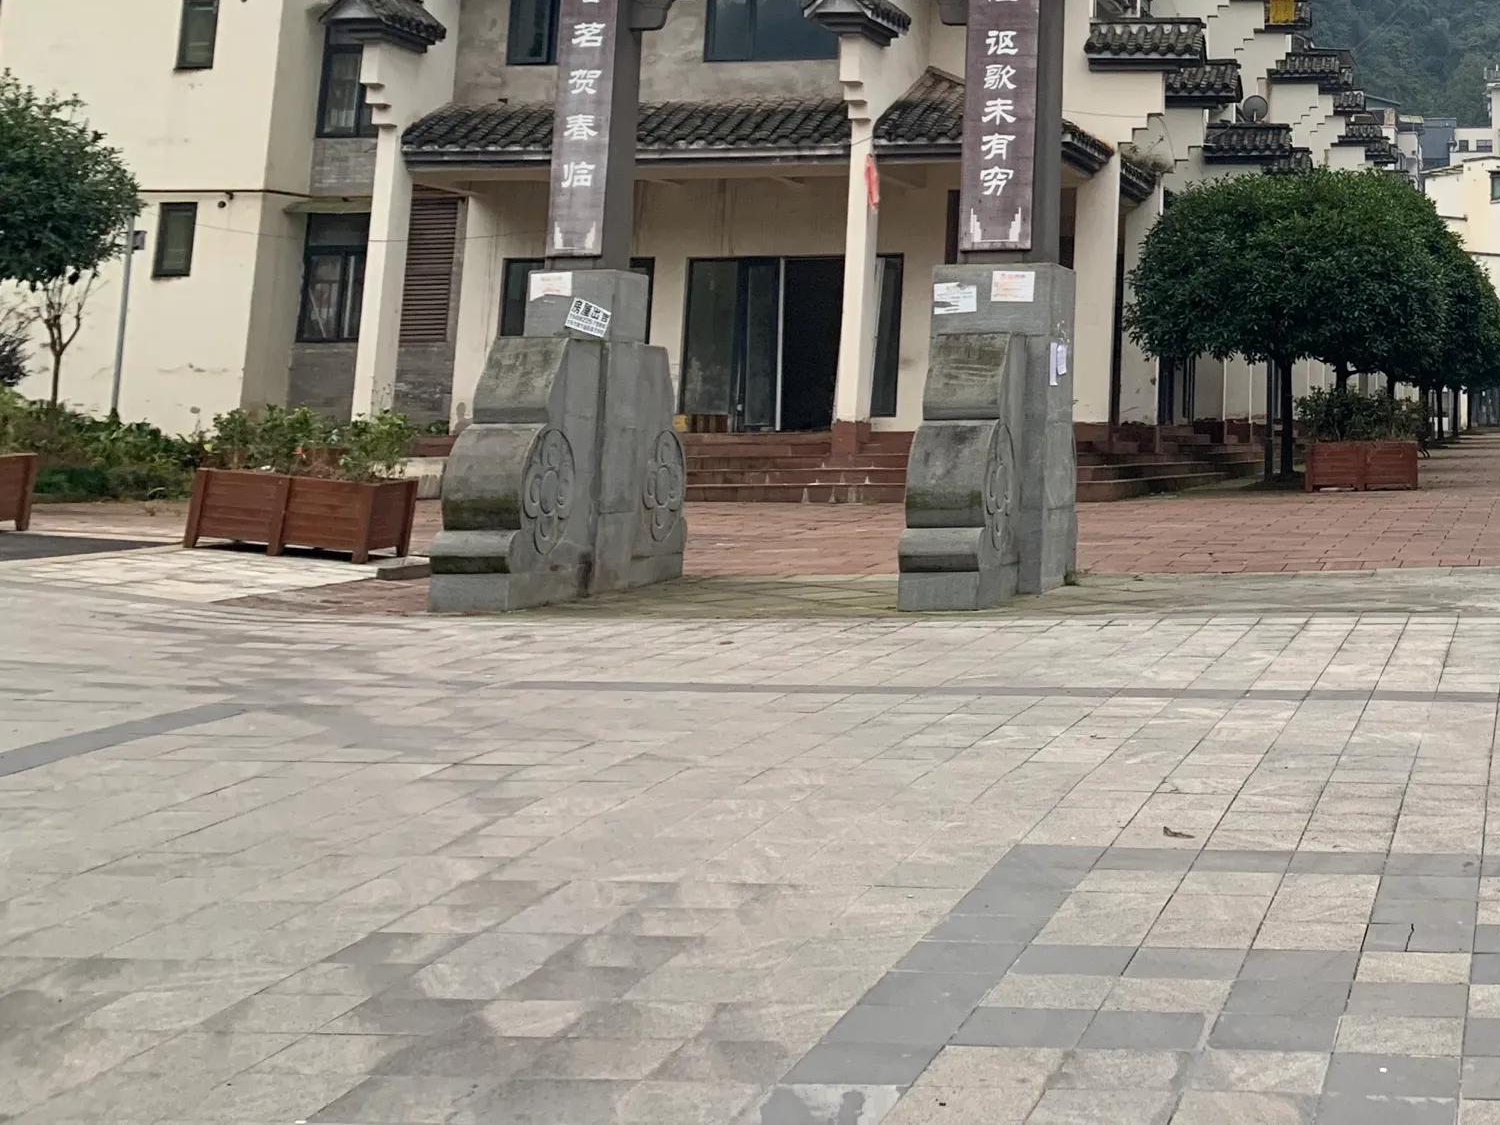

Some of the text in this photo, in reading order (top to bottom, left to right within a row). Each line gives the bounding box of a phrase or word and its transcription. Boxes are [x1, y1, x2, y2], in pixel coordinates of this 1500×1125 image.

[979, 29, 1020, 198] 讴歌未有穷
